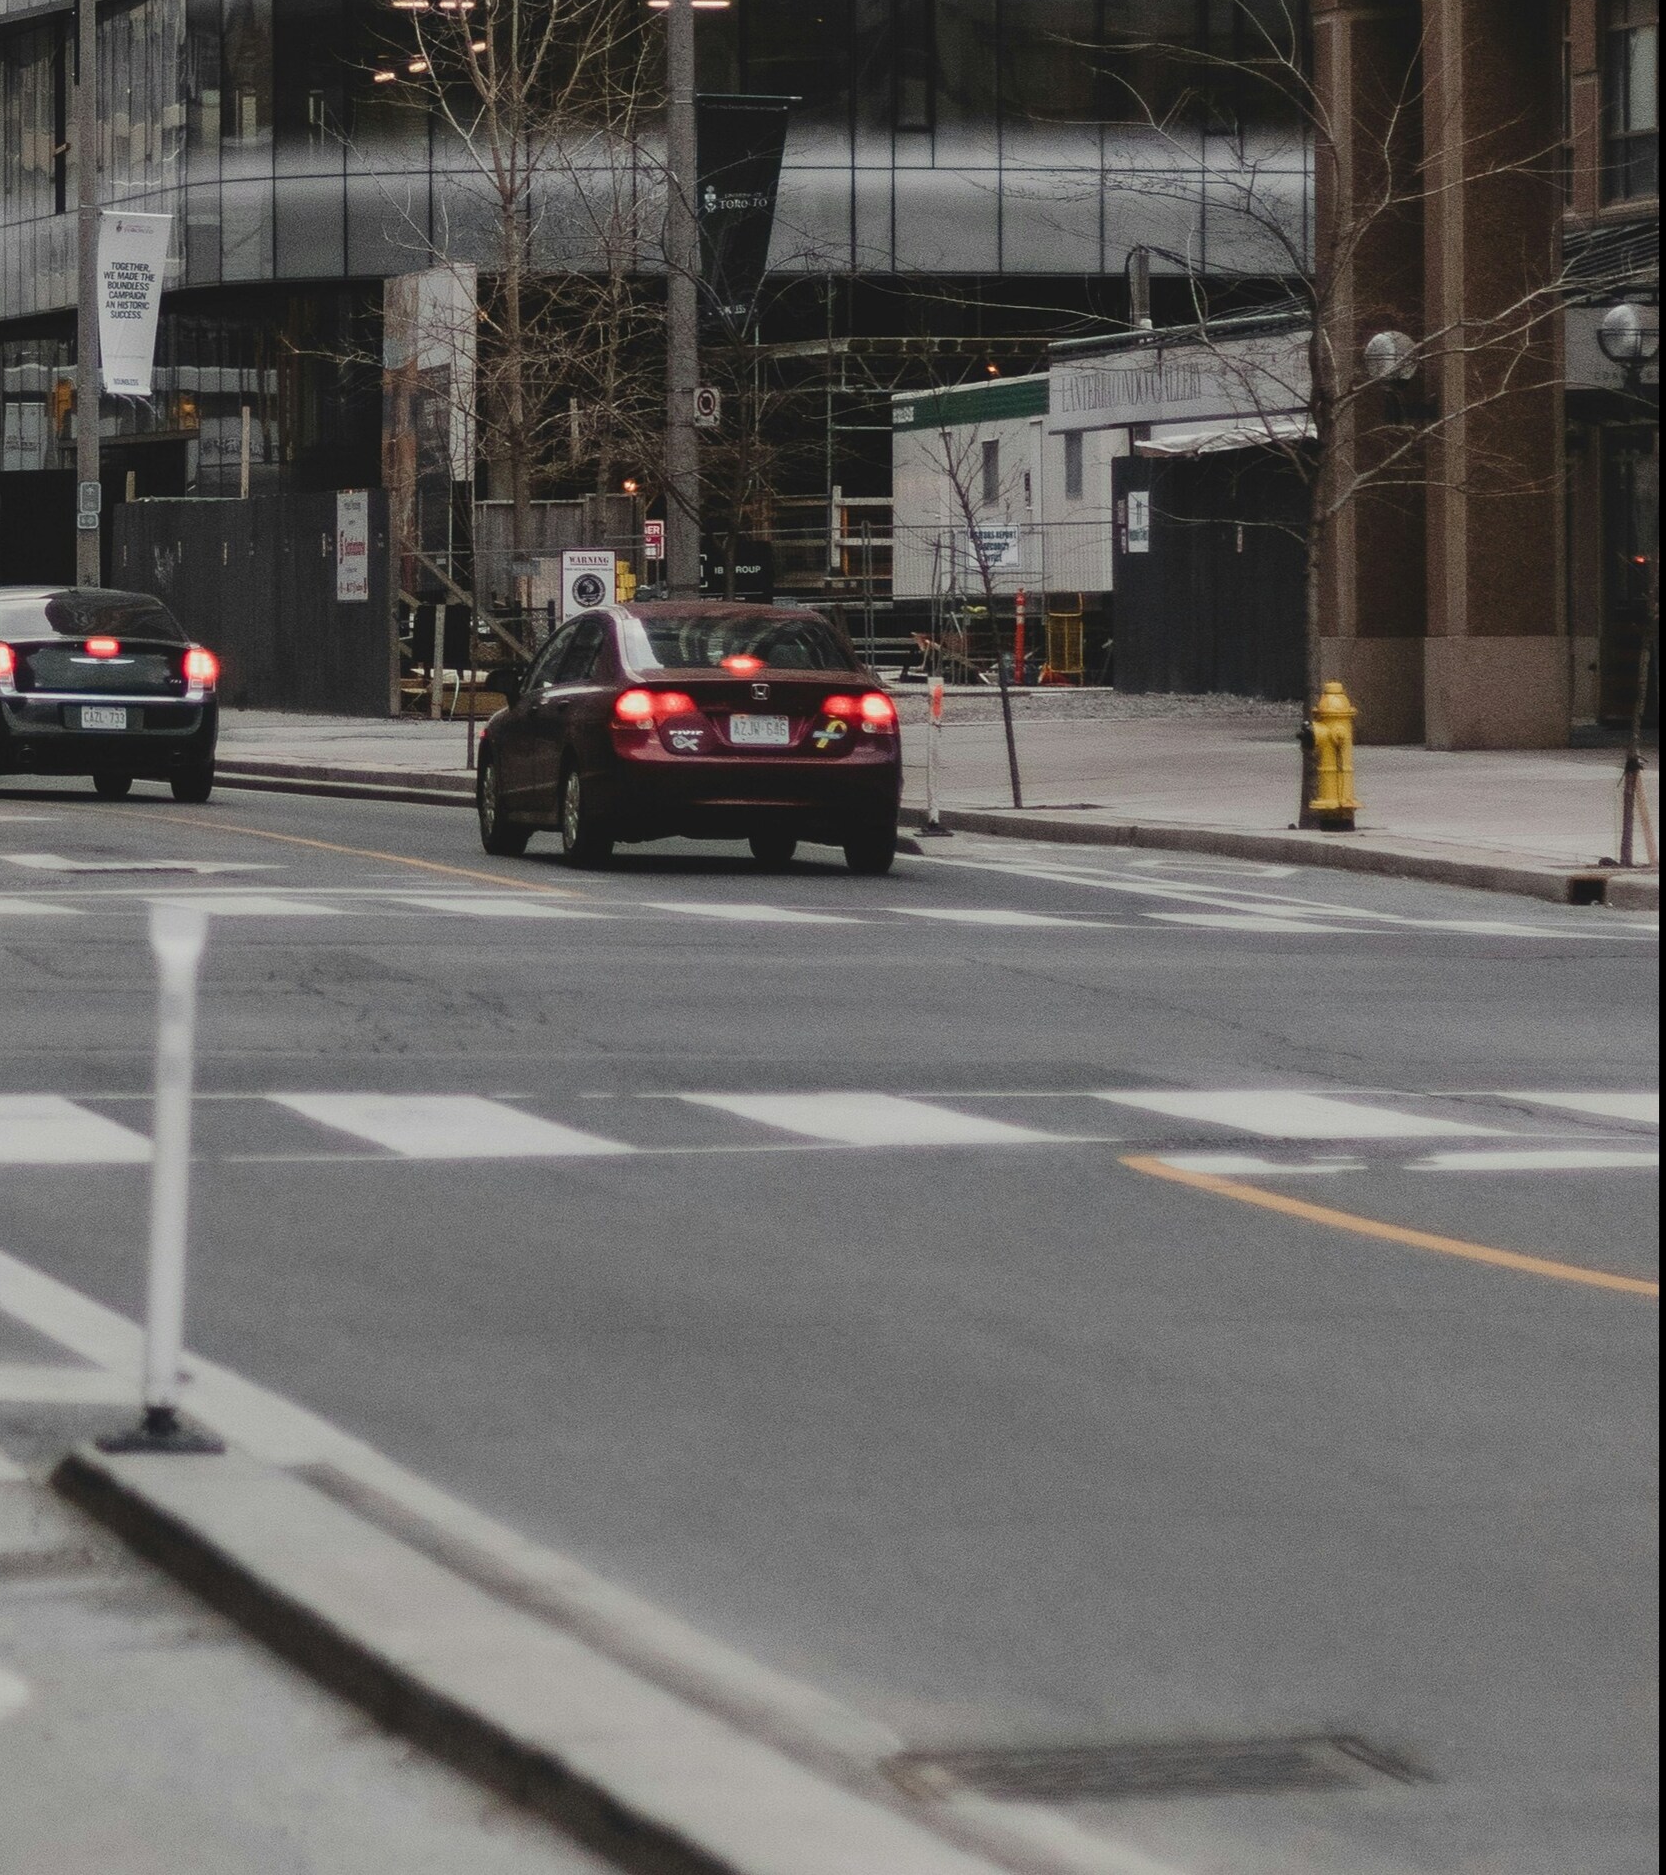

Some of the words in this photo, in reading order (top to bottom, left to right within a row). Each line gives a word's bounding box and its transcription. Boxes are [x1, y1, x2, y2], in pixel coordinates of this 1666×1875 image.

[111, 261, 151, 273] TOGETHER,
[103, 271, 116, 280] WE
[117, 272, 139, 281] MADE
[141, 273, 156, 282] THE
[107, 281, 150, 291] BOUNDLESS
[108, 290, 147, 300] CAMPAIGN
[105, 300, 116, 309] AN
[117, 300, 150, 310] HISTORIC
[110, 310, 143, 319] SUCCESS.
[569, 556, 609, 564] WARNING
[735, 565, 762, 574] ROUP
